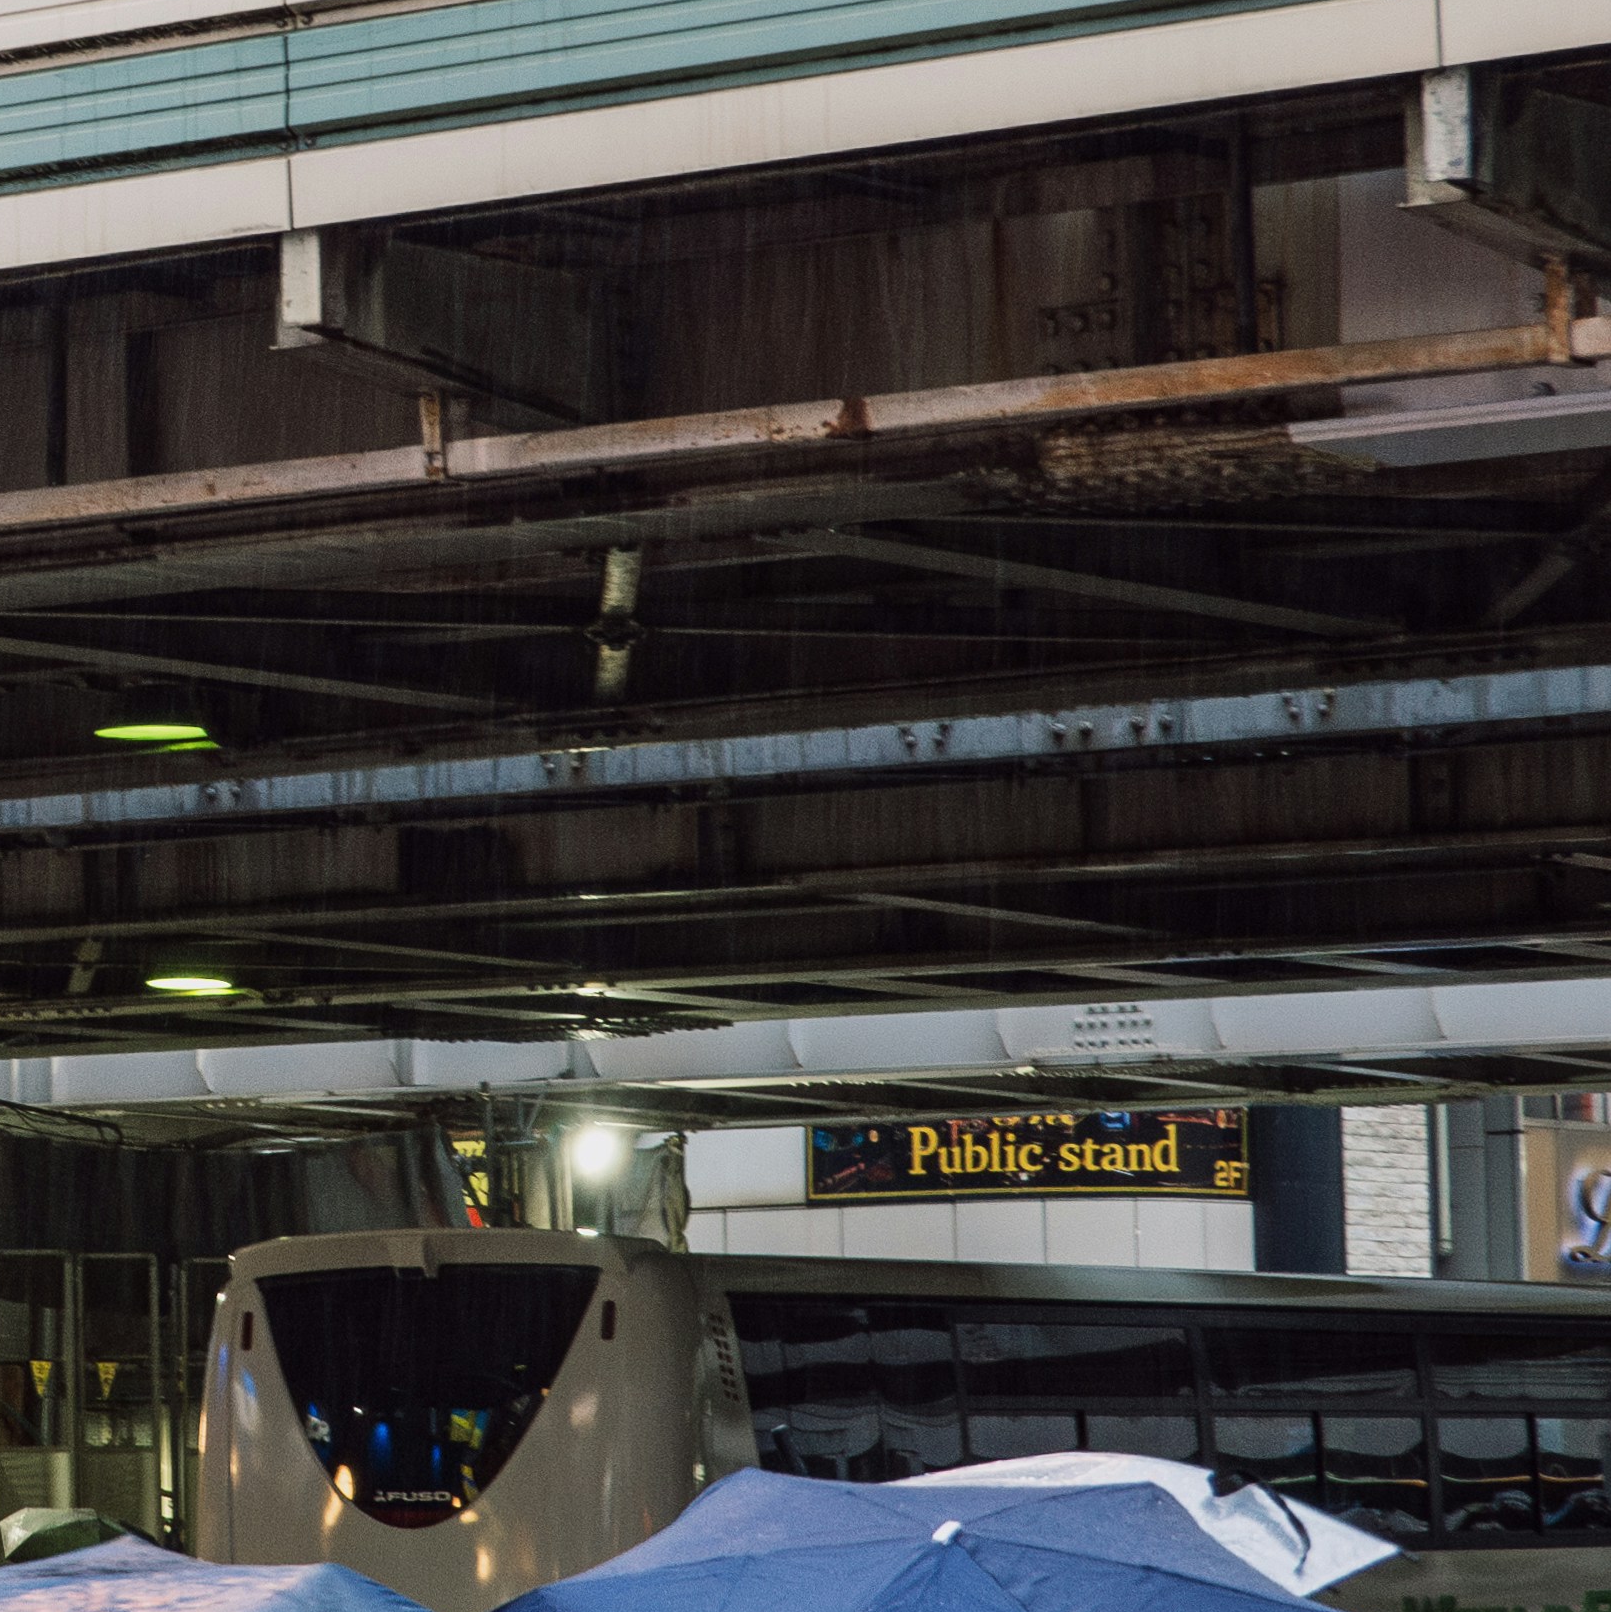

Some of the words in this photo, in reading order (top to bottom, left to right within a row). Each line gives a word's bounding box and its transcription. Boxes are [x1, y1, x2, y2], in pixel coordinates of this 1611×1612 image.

[907, 1126, 1045, 1175] Public
[1057, 1124, 1181, 1173] stand
[1213, 1159, 1249, 1188] 2F
[387, 1491, 451, 1502] FUSO
